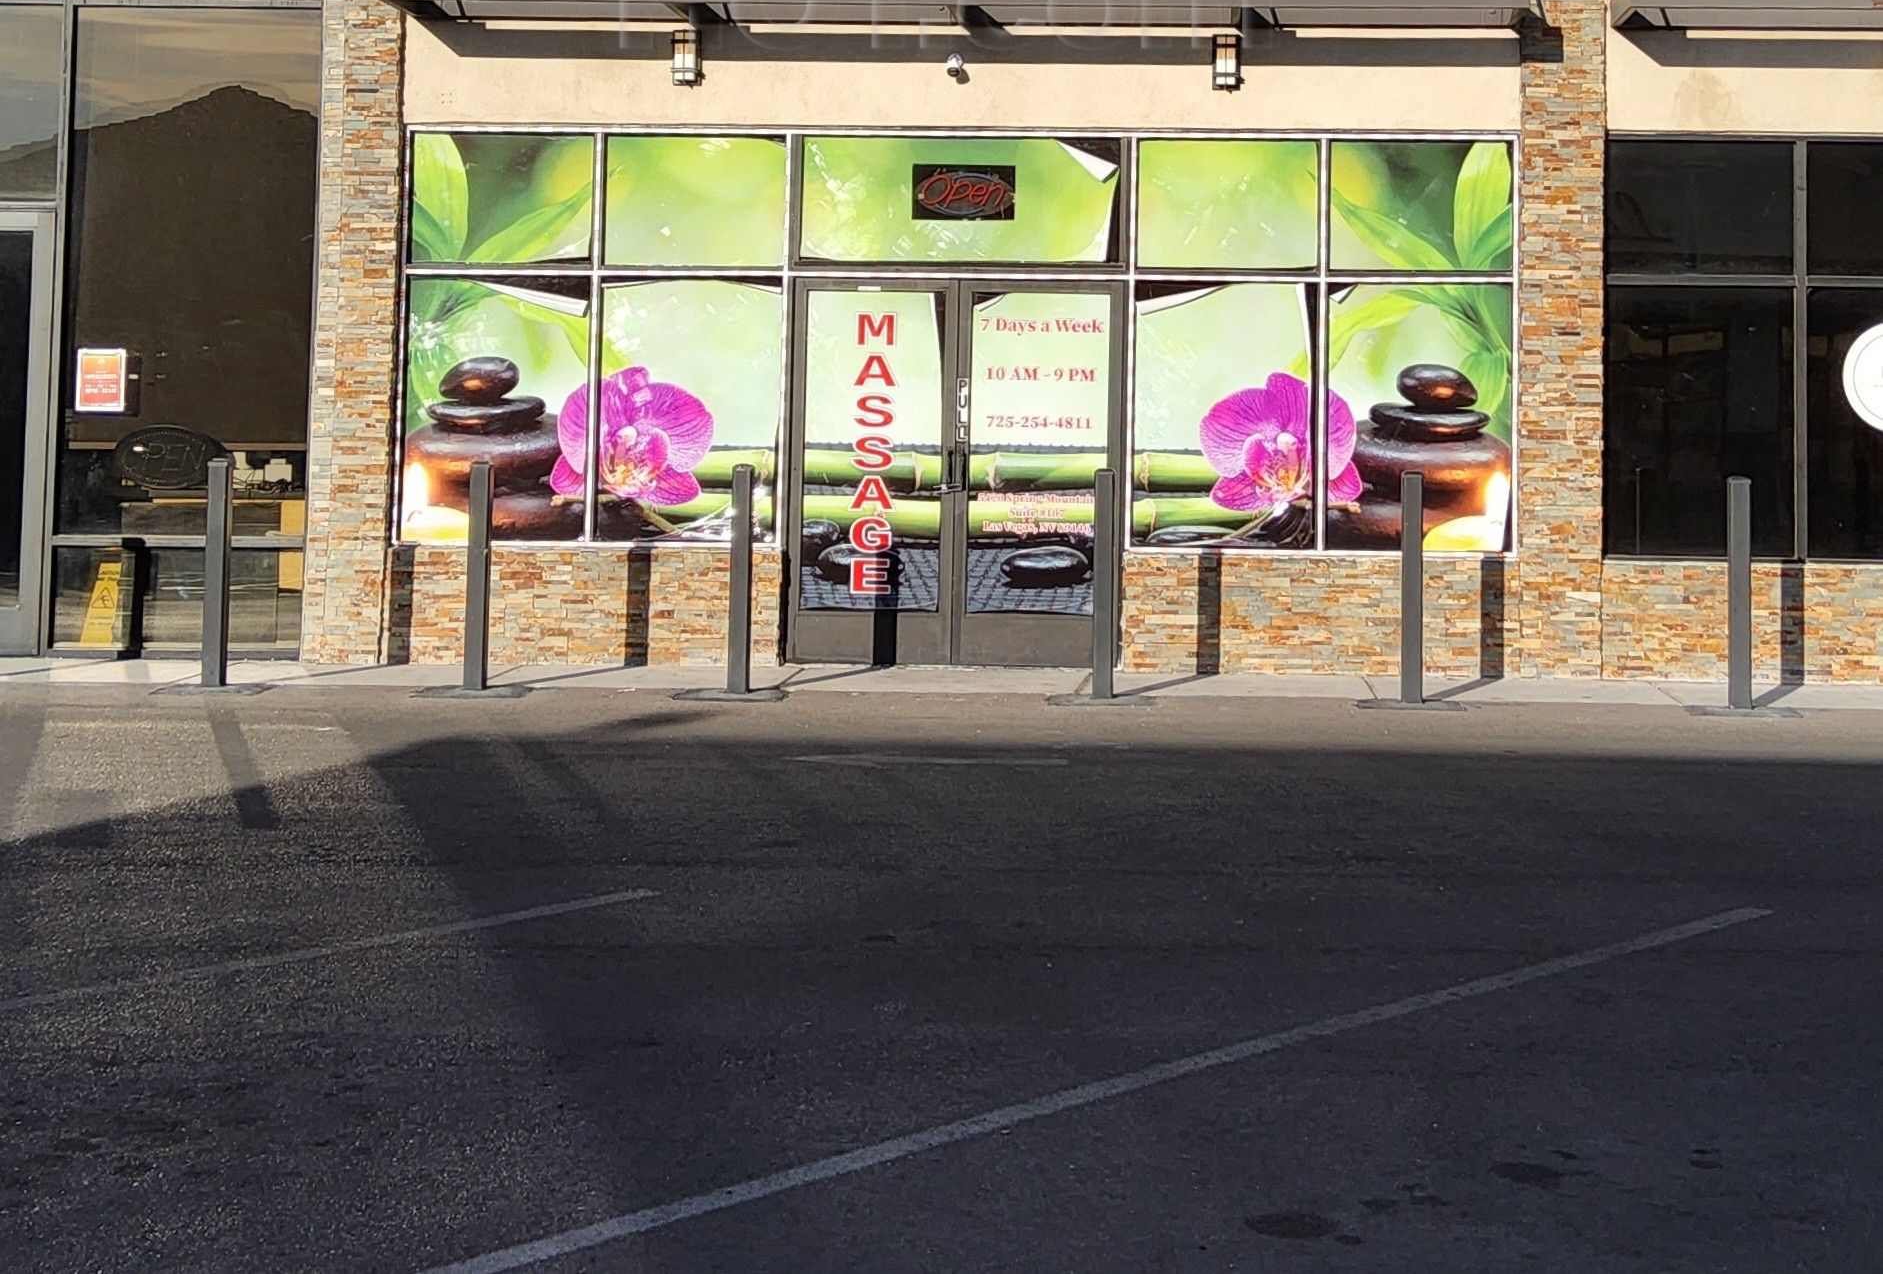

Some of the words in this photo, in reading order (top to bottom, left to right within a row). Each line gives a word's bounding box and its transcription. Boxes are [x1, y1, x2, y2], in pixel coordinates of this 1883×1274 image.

[921, 174, 1005, 209] Open
[981, 318, 992, 331] 7
[995, 318, 1037, 336] Days
[1040, 321, 1051, 332] a
[1055, 318, 1104, 333] Week
[986, 367, 1005, 380] 10
[1010, 367, 1040, 381] AM
[1054, 368, 1064, 381] 9
[1068, 368, 1097, 382] PM
[957, 379, 968, 440] PULL
[986, 415, 1094, 429] 725-254-4811
[849, 312, 897, 594] MASSAGE
[1005, 493, 1043, 505] Spring
[1009, 507, 1037, 517] Suite
[982, 521, 1003, 532] Las
[1039, 522, 1056, 533] NV
